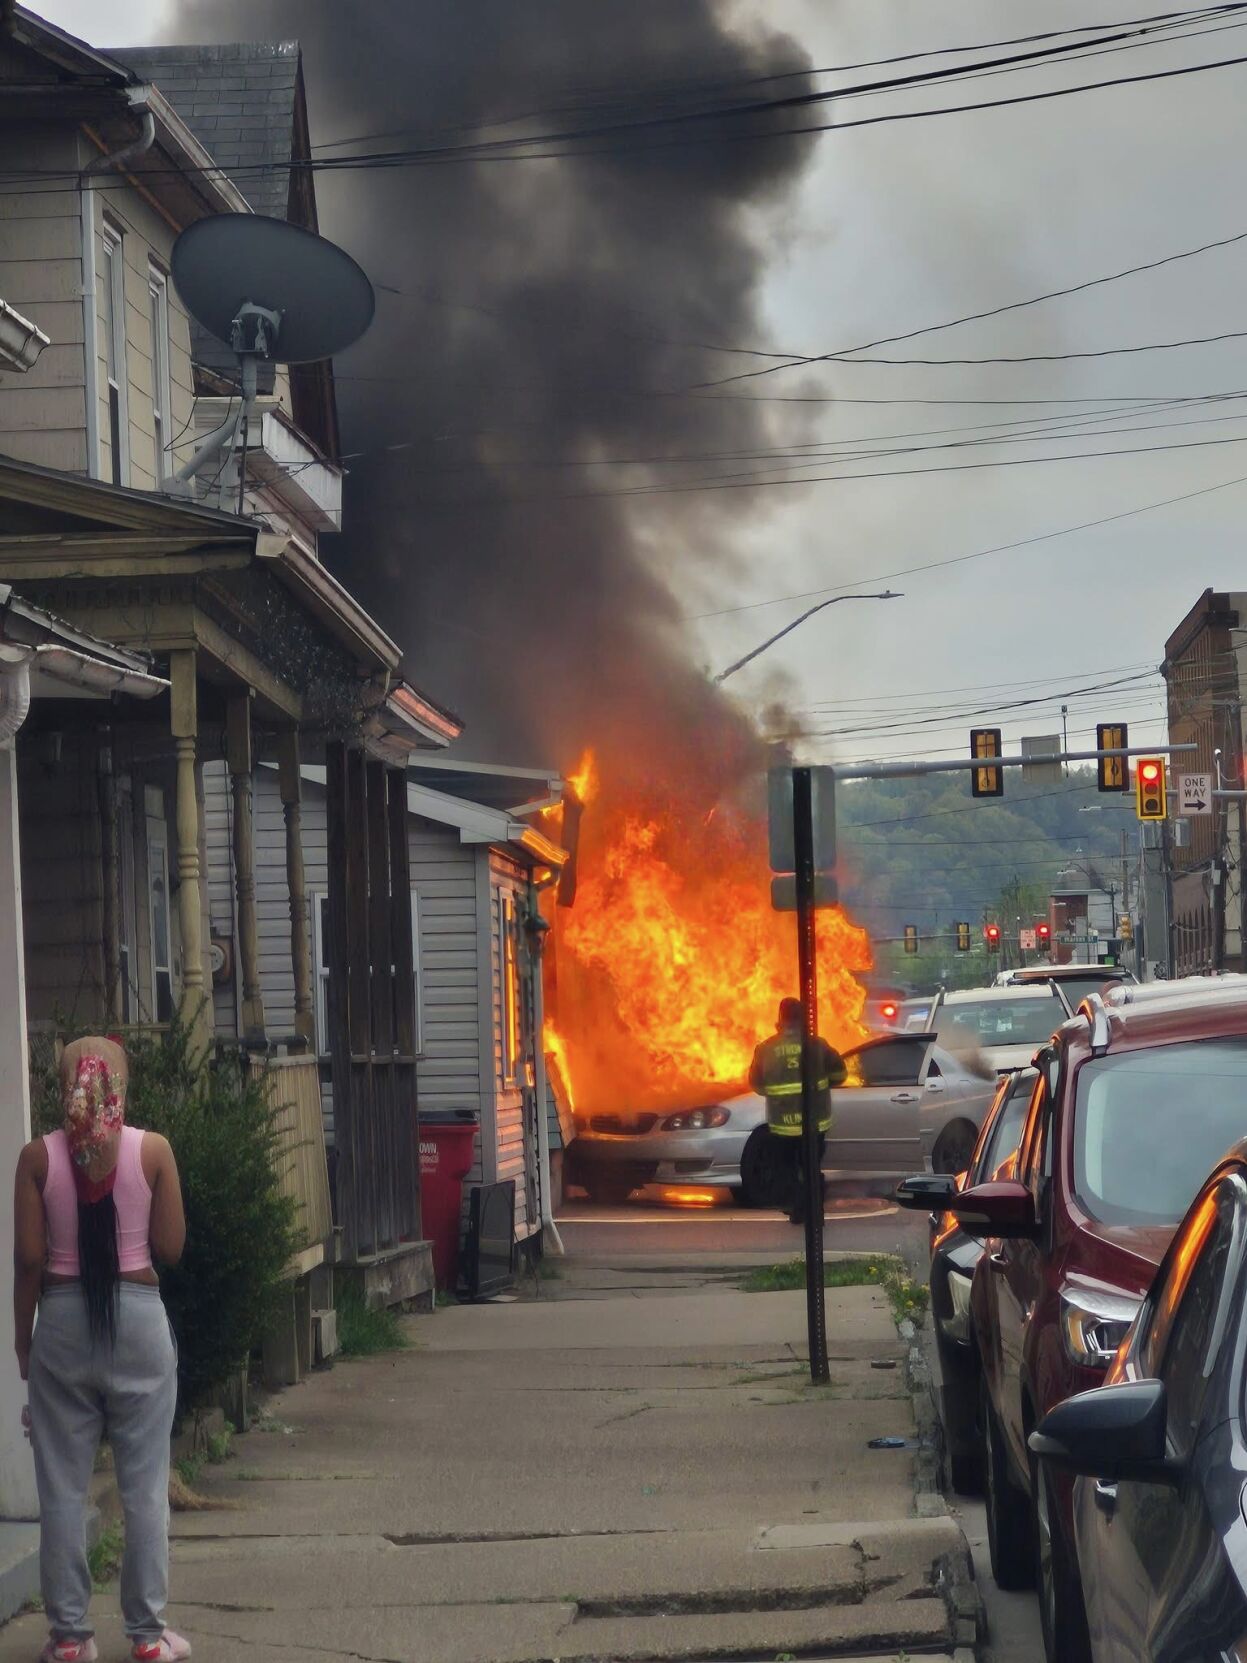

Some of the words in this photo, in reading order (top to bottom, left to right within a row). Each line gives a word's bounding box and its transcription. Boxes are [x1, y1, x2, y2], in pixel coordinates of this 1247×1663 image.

[1184, 777, 1205, 787] ONE
[1184, 789, 1206, 798] WAY
[419, 1142, 437, 1154] OWN
